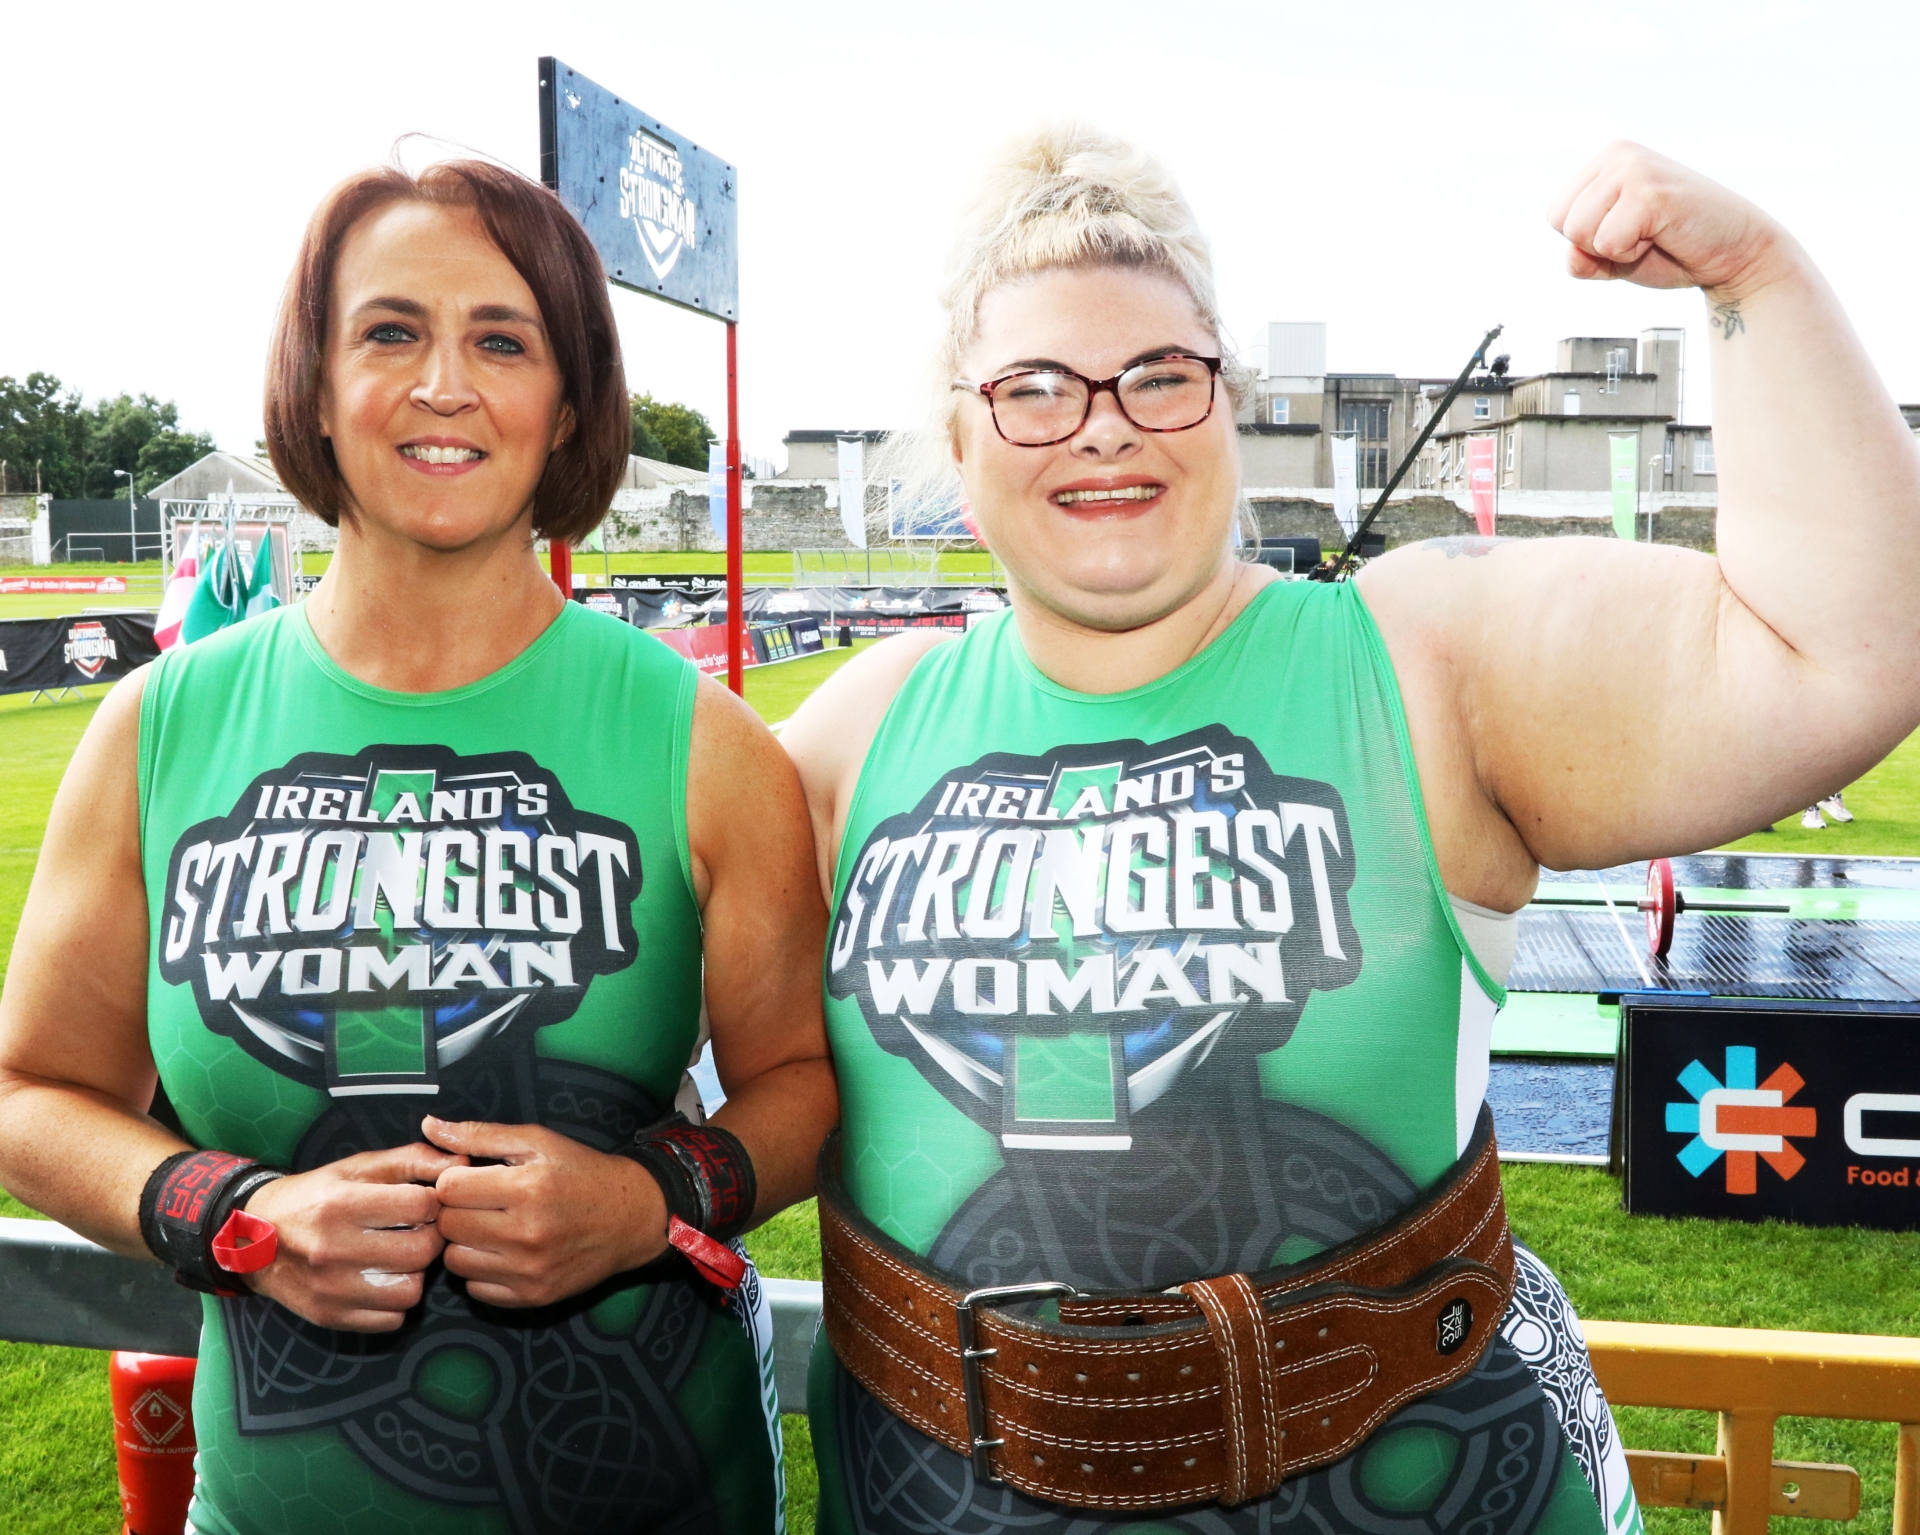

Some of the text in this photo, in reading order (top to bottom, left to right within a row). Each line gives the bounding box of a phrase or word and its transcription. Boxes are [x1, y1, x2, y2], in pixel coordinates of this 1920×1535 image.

[629, 135, 682, 185] ULTIMATE
[620, 167, 695, 249] STRONGMAN
[64, 639, 117, 664] STRONGMAN
[801, 630, 821, 644] SCANIA
[254, 782, 548, 823] IRELAND'S
[933, 753, 1246, 822] IRELAND'S
[165, 829, 630, 963] STRONGEST
[831, 802, 1349, 974] STRONGEST
[199, 941, 581, 1000] WOMAN
[865, 942, 1297, 1015] WOMAN
[1847, 1166, 1909, 1187] Food
[1442, 1305, 1455, 1347] 3XL
[1454, 1304, 1463, 1339] SIZE
[156, 1388, 187, 1416] FLAMMABLE
[139, 1445, 151, 1453] AND
[152, 1446, 165, 1454] USE
[167, 1445, 197, 1454] OUTDOO
